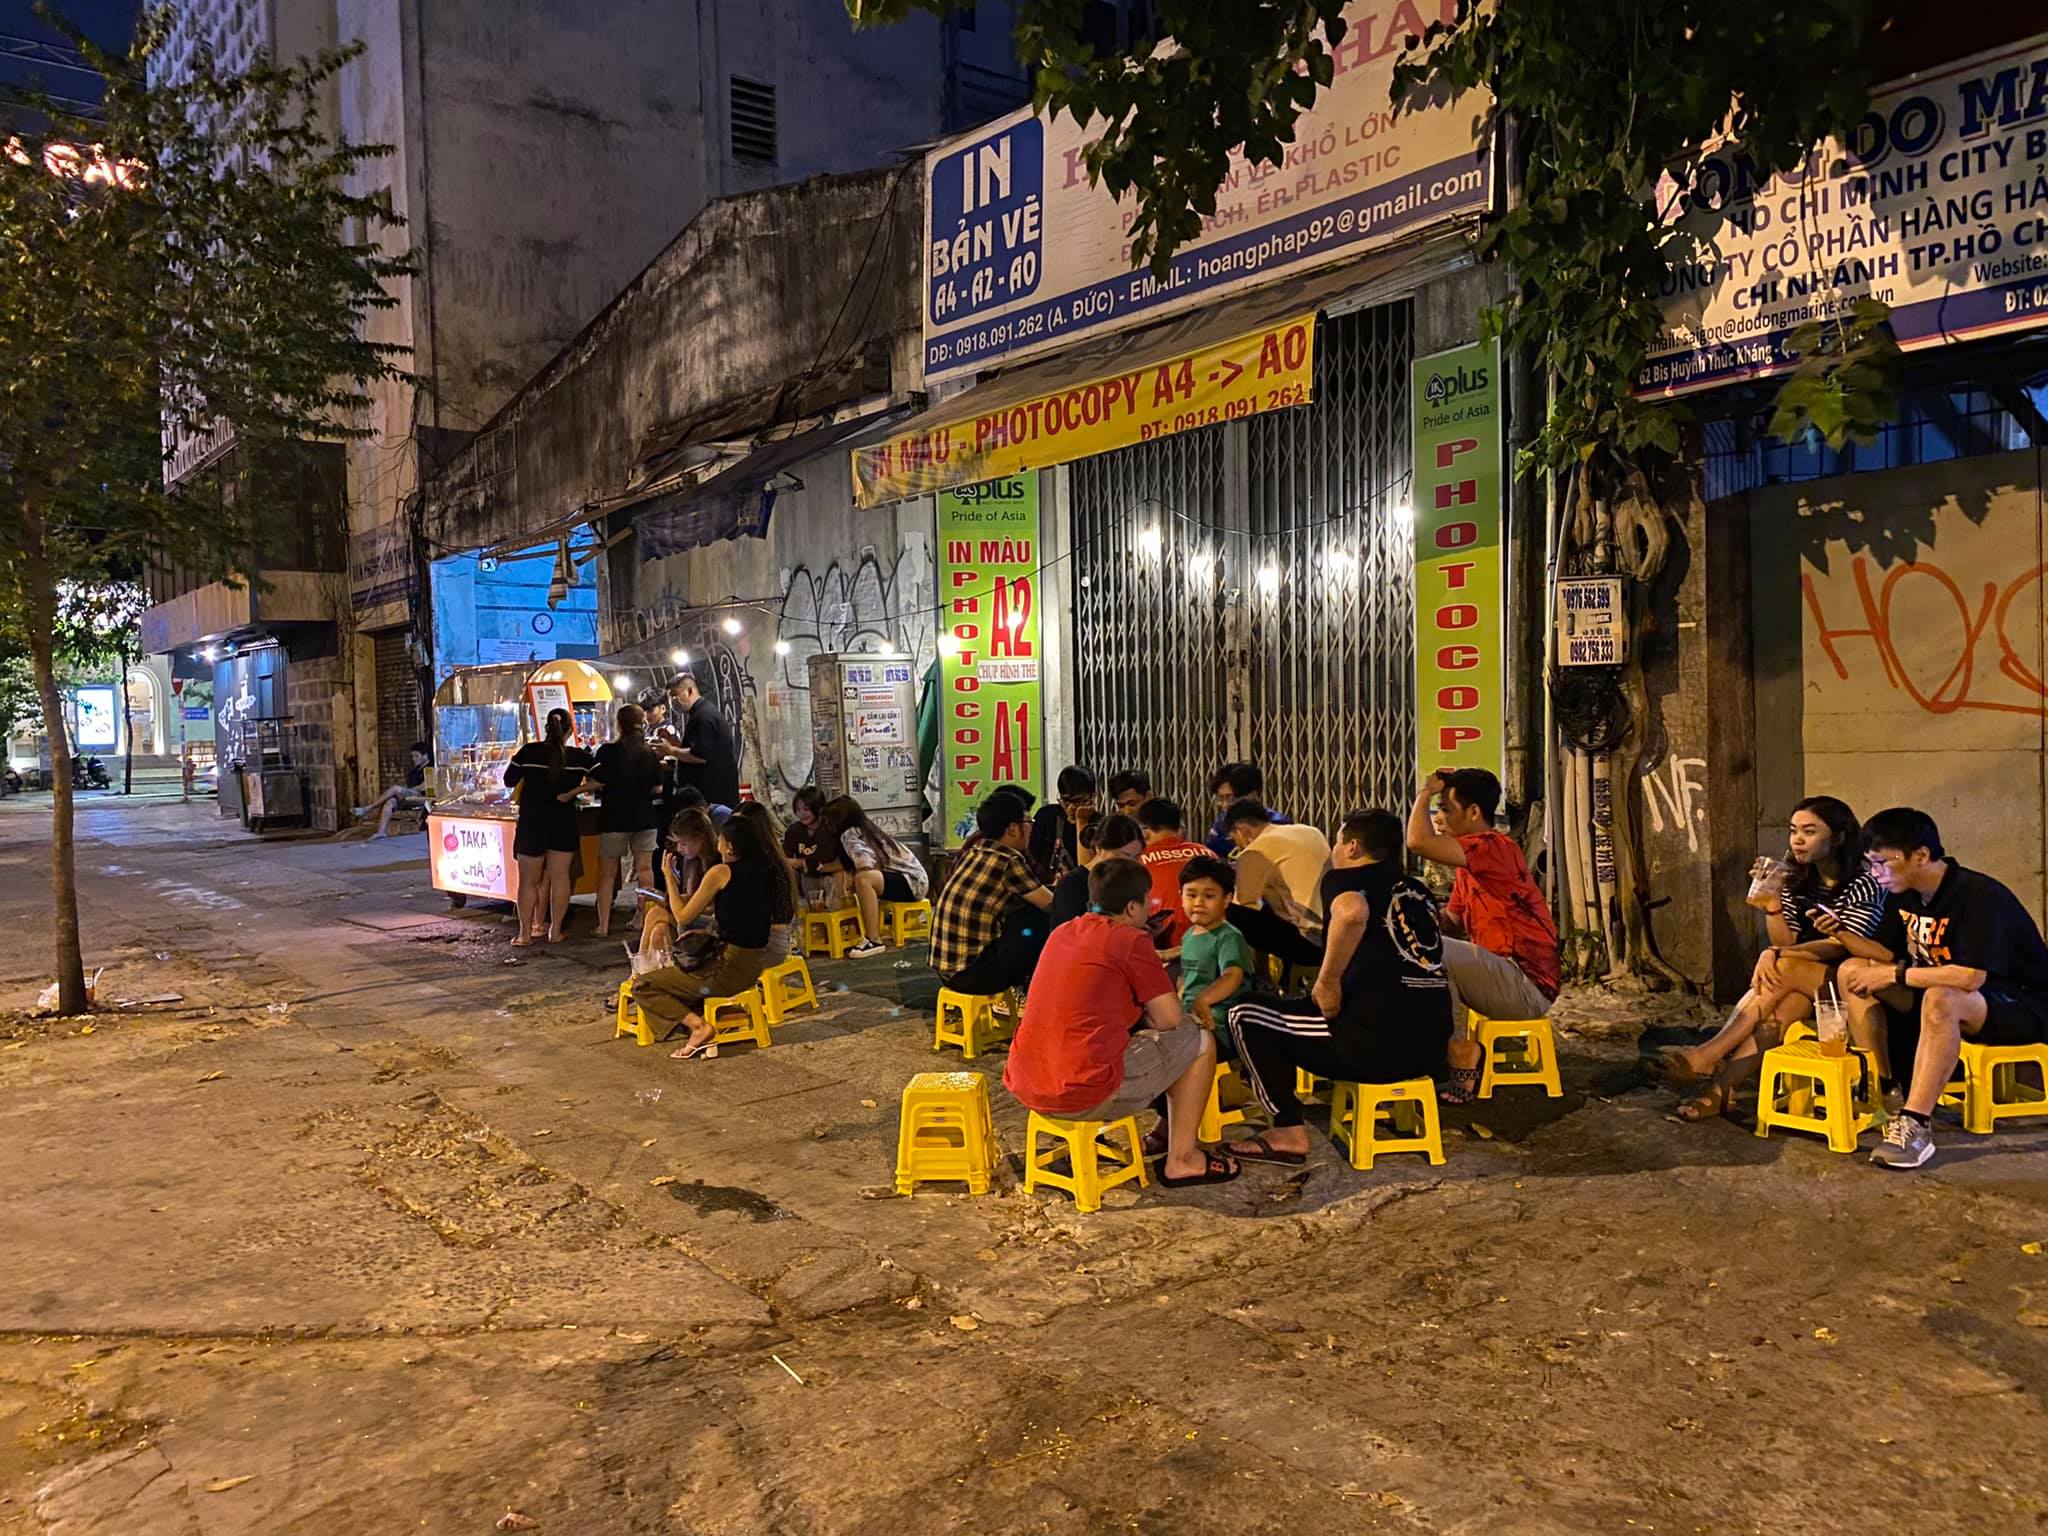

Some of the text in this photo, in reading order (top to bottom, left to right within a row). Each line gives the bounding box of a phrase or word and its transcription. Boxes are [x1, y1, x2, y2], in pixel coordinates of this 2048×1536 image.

[1845, 96, 1943, 169] DO
[963, 135, 1011, 214] IN
[1295, 146, 1401, 201] PLASTIC
[1780, 187, 1829, 223] CHI
[1840, 160, 1928, 207] MINH
[1939, 136, 2015, 182] CITY
[929, 344, 953, 365] DĐ:
[955, 313, 1043, 357] 0918.091.262
[1198, 169, 1482, 280] hoangphap92@gmail.com
[932, 194, 1041, 278] BẢN VẼ
[1723, 249, 1754, 281] TY
[1900, 190, 1993, 239] HÀNG
[1732, 280, 1778, 310] CHI
[1908, 222, 2002, 271] TP.HỒ
[1974, 253, 2047, 283] Website:
[936, 281, 957, 320] A4
[972, 267, 993, 307] A2
[1653, 364, 1669, 382] Bis
[1736, 343, 1773, 365] Kháng
[975, 373, 1142, 455] PHOTOCOPY
[1152, 358, 1196, 408] A4
[1174, 406, 1218, 432] 0918
[1225, 395, 1258, 421] 091
[1268, 384, 1305, 410] 262
[1423, 404, 1490, 430] Pride of Asia
[948, 535, 1031, 564] IN MÀU
[952, 511, 1026, 521] Pride of Asia
[990, 576, 1032, 657] A2
[1434, 437, 1482, 773] PHOTOCOP
[991, 700, 1029, 781] A1
[460, 830, 488, 849] TAKA
